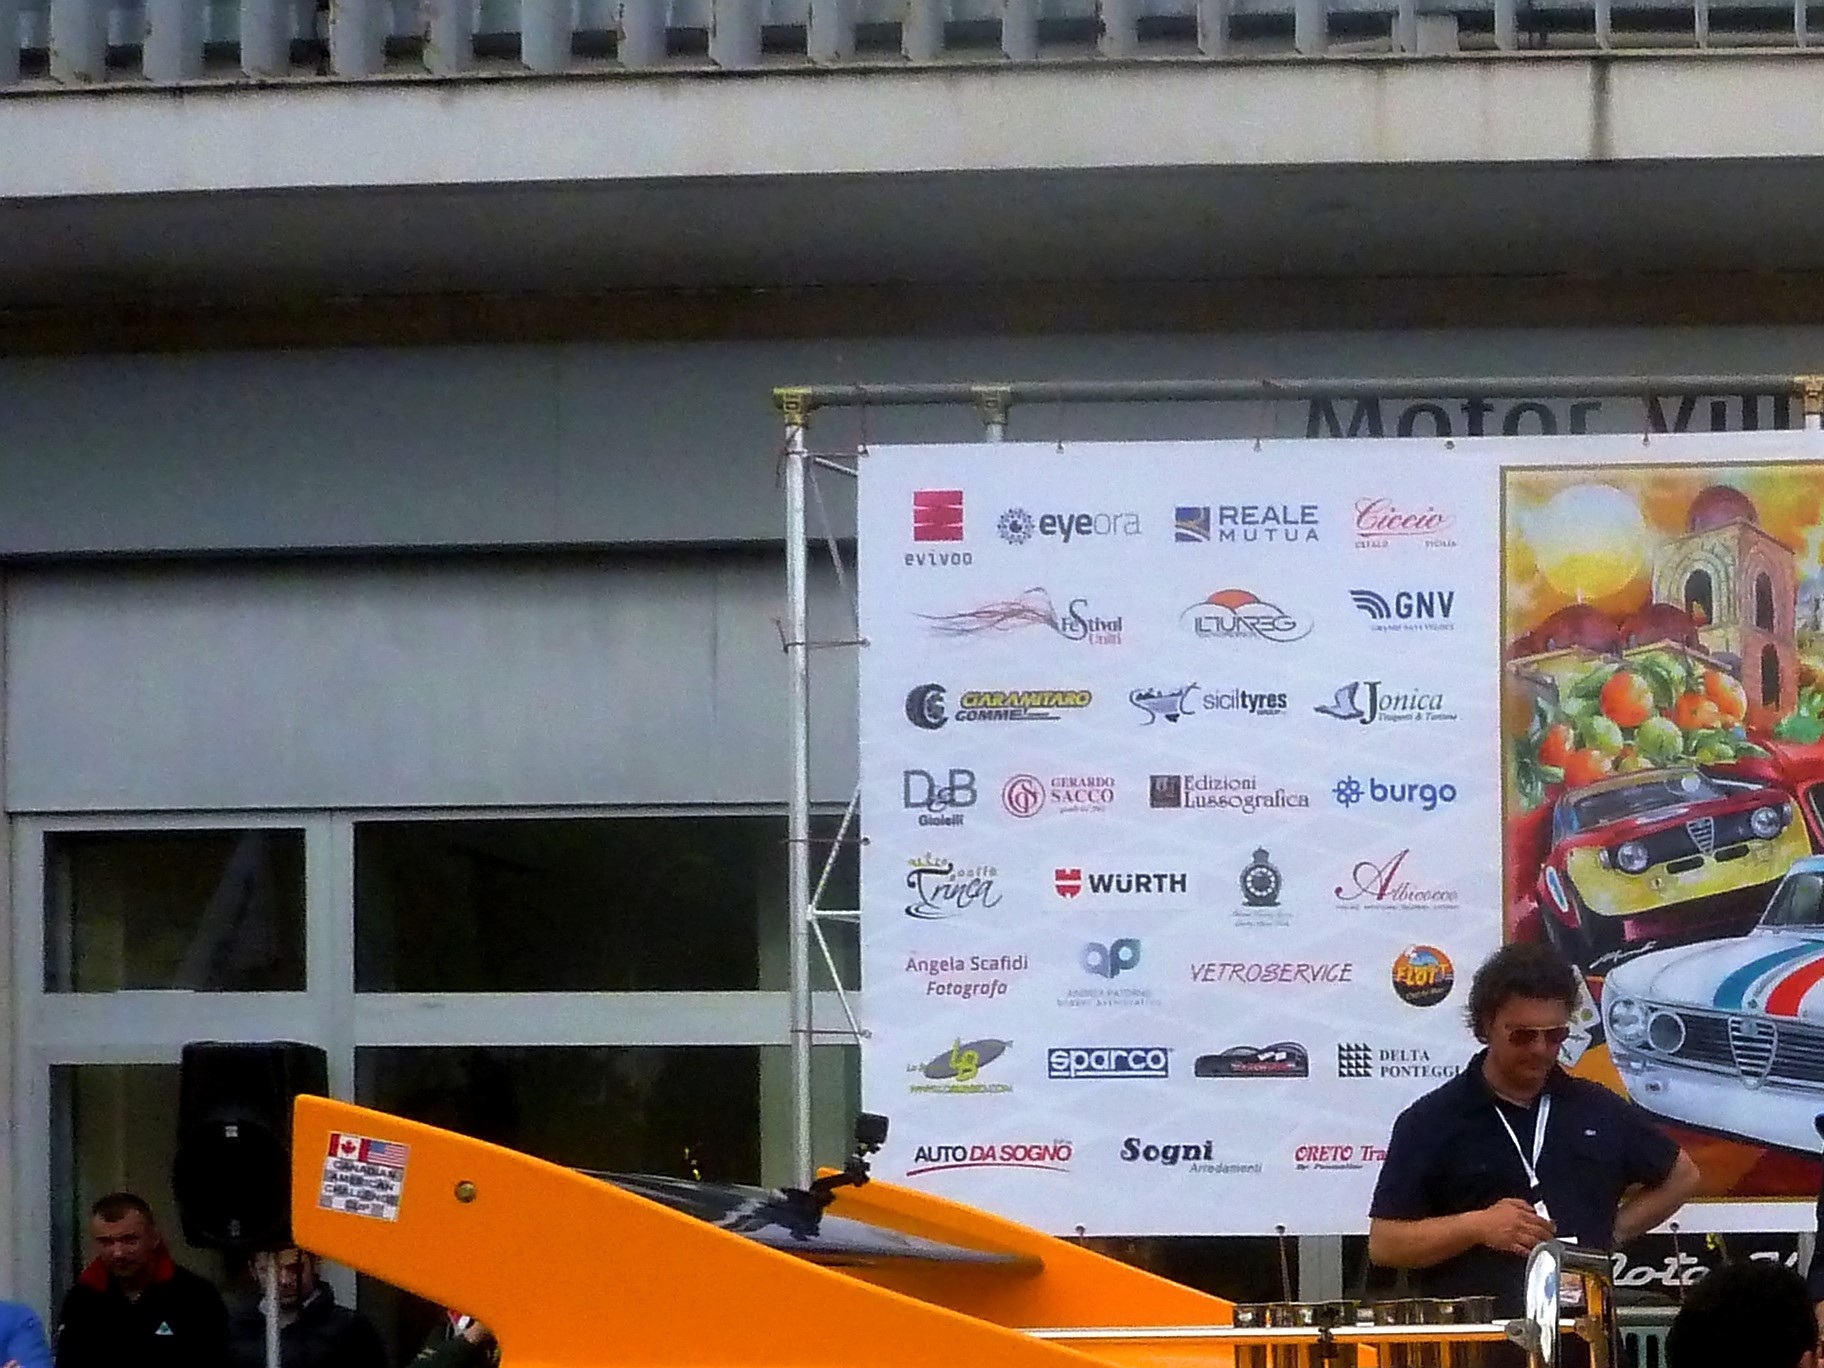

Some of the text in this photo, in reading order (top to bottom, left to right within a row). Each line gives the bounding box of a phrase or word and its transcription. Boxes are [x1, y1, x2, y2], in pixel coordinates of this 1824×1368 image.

[1219, 505, 1319, 526] REALE
[1038, 512, 1142, 543] eyeora
[1219, 528, 1320, 542] MUTUA
[1395, 591, 1455, 619] GNV
[1202, 687, 1288, 714] siciltyres
[1359, 680, 1444, 725] Jonica
[1051, 776, 1116, 788] GERARDO
[1183, 774, 1257, 790] Edizioni
[1051, 788, 1115, 804] SACCO
[1183, 787, 1310, 814] Lussografica
[1369, 777, 1457, 811] burgo
[905, 954, 1029, 976] Angela Scafidi
[1190, 963, 1353, 983] VETROSERVICE
[1050, 1050, 1168, 1077] sparco
[1379, 1049, 1431, 1062] DELTA
[914, 1144, 1073, 1163] AUTO DA SOGNO
[1120, 1137, 1214, 1165] Sogni
